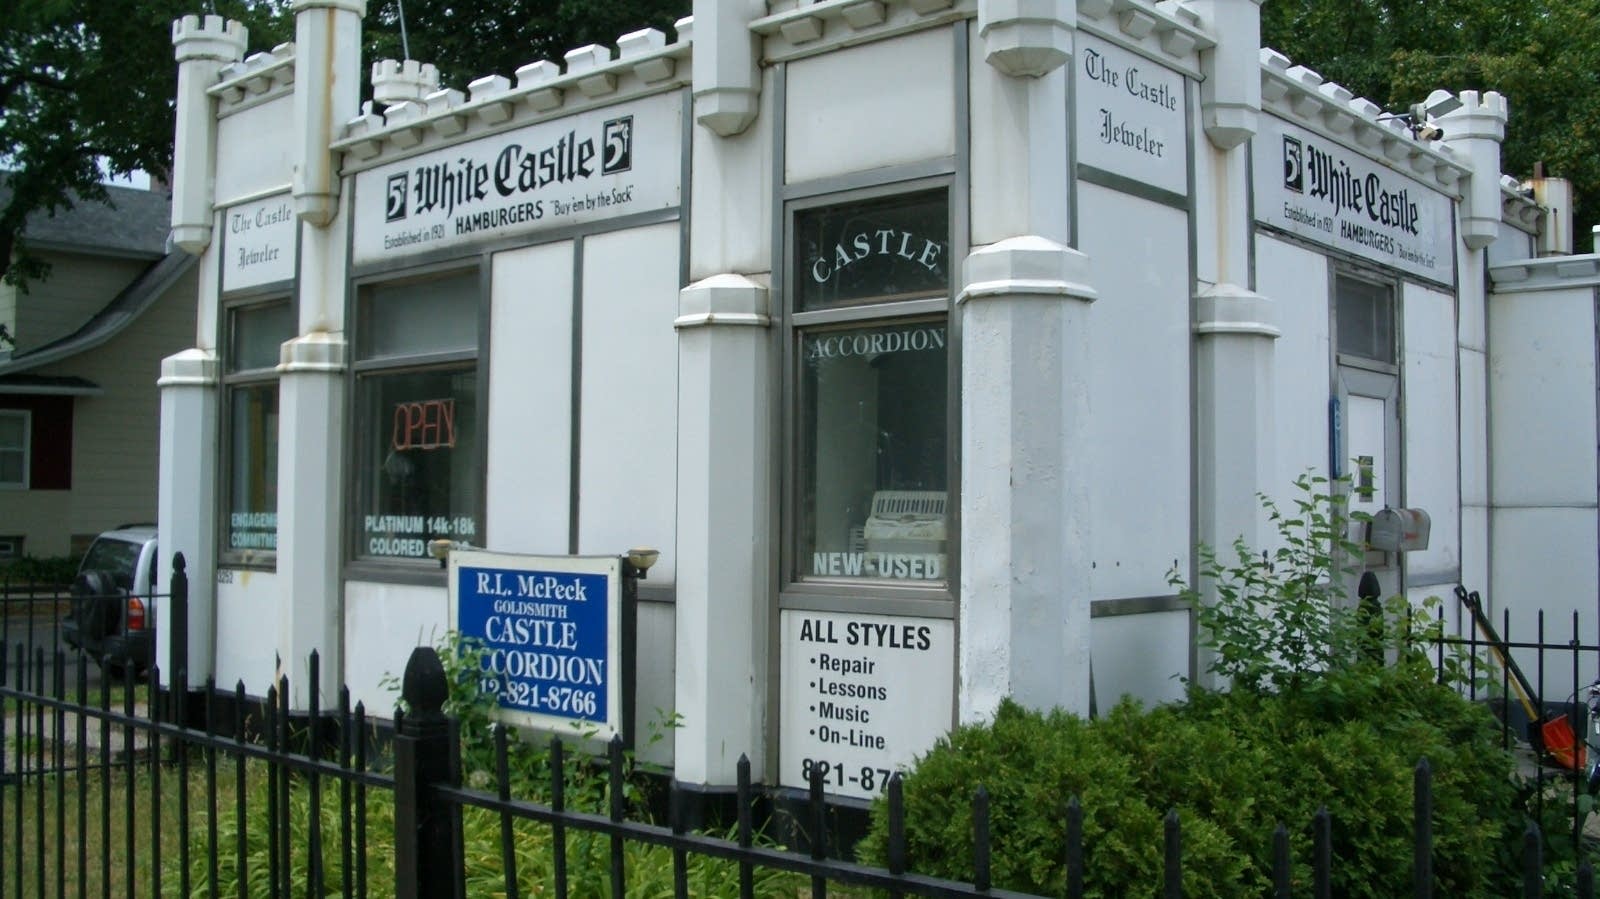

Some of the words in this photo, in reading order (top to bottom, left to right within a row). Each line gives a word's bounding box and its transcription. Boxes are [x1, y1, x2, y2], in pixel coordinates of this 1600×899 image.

[1084, 48, 1119, 87] The
[1125, 66, 1176, 112] Castle
[1100, 108, 1164, 158] Jeweler
[414, 158, 489, 218] White
[494, 130, 597, 197] Castle
[1307, 144, 1362, 216] White
[1365, 172, 1419, 236] Castle
[231, 213, 251, 234] The
[255, 203, 291, 228] Castle
[455, 201, 544, 236] HAMBURGERS
[586, 193, 597, 211] by
[597, 191, 611, 208] the
[1340, 219, 1394, 255] HAMBURGERS
[238, 244, 280, 270] Jeweler
[812, 228, 941, 283] CASTLE
[811, 328, 945, 359] ACCORDION
[392, 401, 456, 451] OPEN
[364, 515, 424, 534] PLATINUM
[369, 537, 424, 557] COLORED
[476, 572, 512, 596] R.L.
[517, 574, 587, 601] McPeck
[494, 600, 567, 619] GOLDSMITH
[485, 616, 578, 651] CASTLE
[800, 619, 838, 644] ALL
[846, 622, 931, 651] STYLES
[470, 646, 603, 686] CCORDION
[819, 653, 875, 676] Repair
[819, 677, 887, 701] Lessons
[819, 701, 870, 723] Music
[819, 725, 886, 750] On-Line
